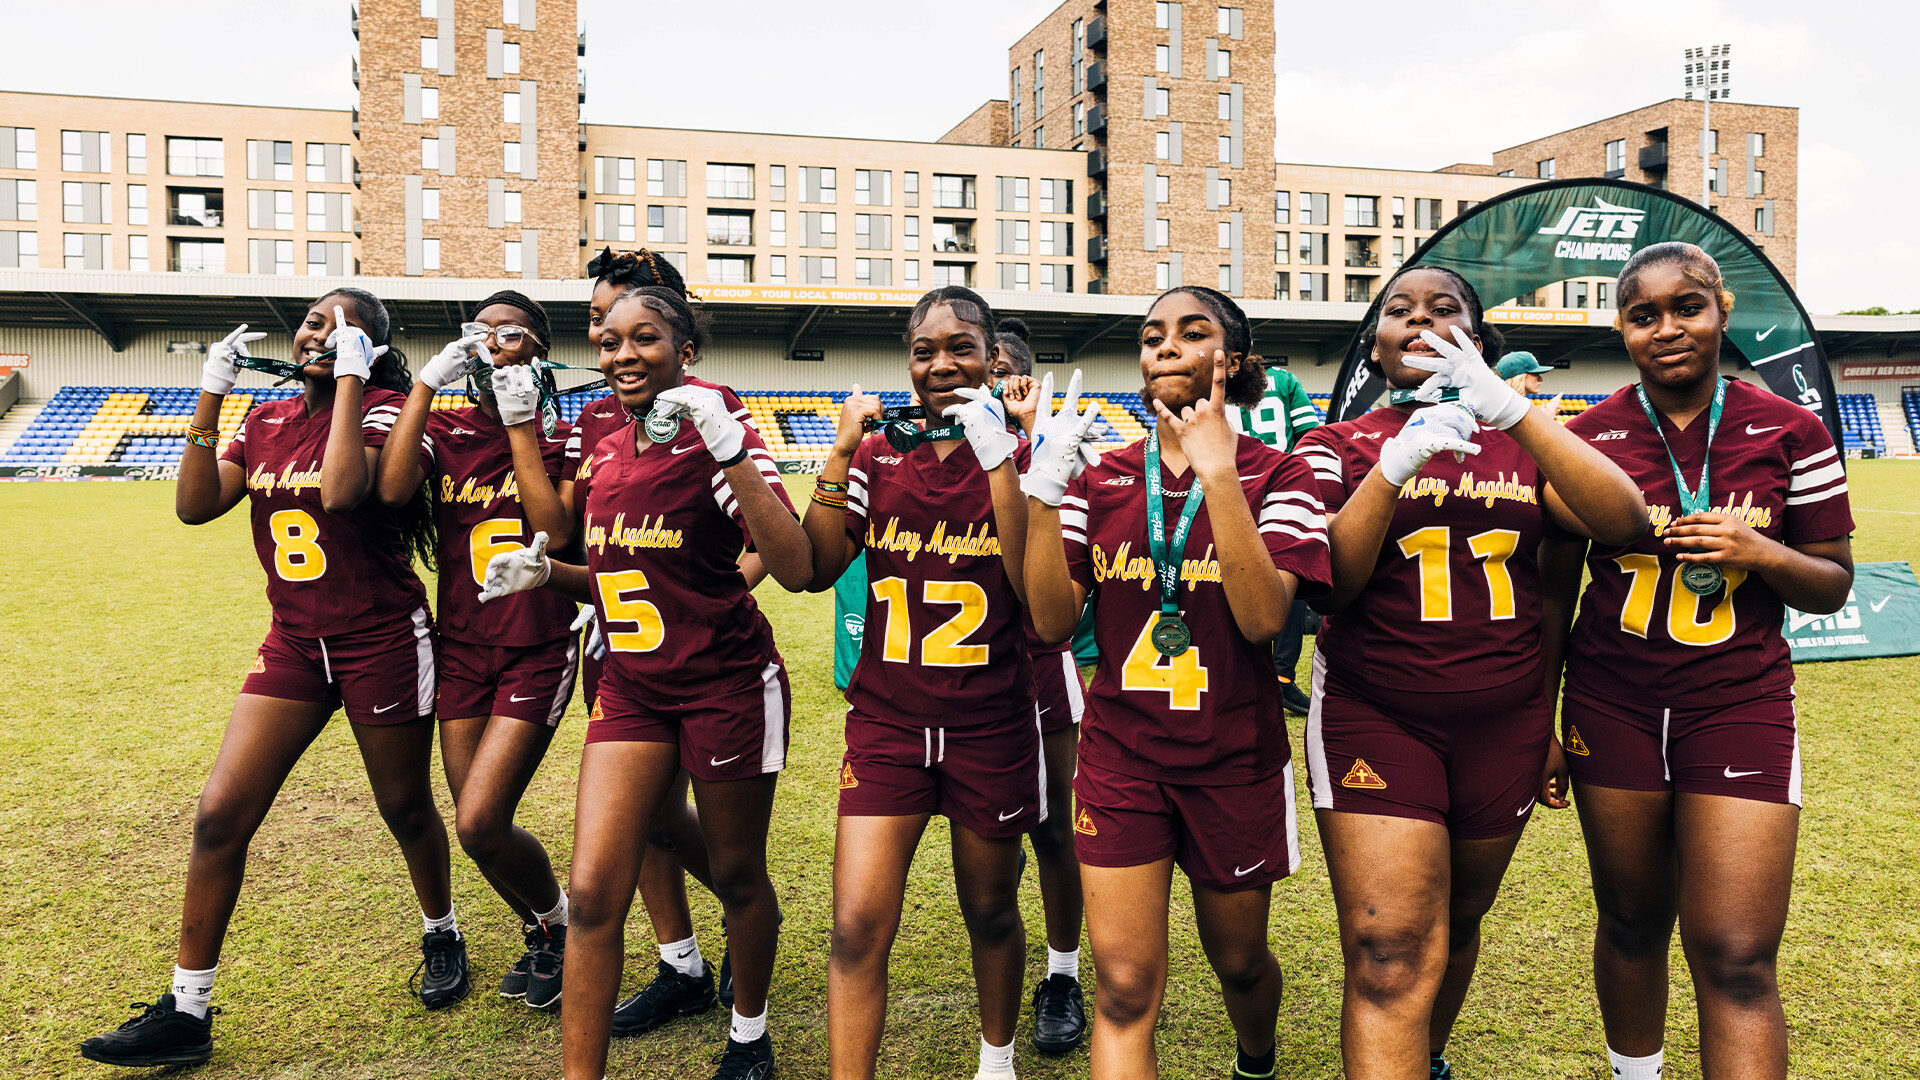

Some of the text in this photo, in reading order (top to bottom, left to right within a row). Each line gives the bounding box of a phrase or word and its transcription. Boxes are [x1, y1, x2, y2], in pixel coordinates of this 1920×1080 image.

[1538, 197, 1647, 239] JETS
[1554, 240, 1633, 261] CHAMPIONS
[713, 288, 752, 298] GROUP
[761, 289, 791, 299] YOUR
[793, 290, 828, 300] LOCAL
[830, 291, 878, 301] TRUSTED
[1491, 311, 1584, 321] THE RY GROUP STAND
[1844, 366, 1877, 376] CHERRY
[1877, 366, 1894, 375] RED
[932, 428, 950, 438] FLAG
[1590, 429, 1630, 441] JETS
[440, 474, 455, 503] St
[456, 476, 495, 509] Mary
[1098, 475, 1136, 486] JETS
[269, 508, 327, 582] 8
[469, 518, 524, 587] 6
[608, 512, 683, 556] Magdalene
[877, 516, 922, 562] Mary
[1092, 543, 1107, 582] St
[1106, 541, 1157, 591] Mary
[1396, 525, 1521, 622] 11
[595, 569, 665, 652] 5
[1612, 552, 1747, 647] 10
[871, 576, 989, 667] 12
[1834, 634, 1870, 645] FOOTBALL
[1121, 610, 1209, 711] 4
